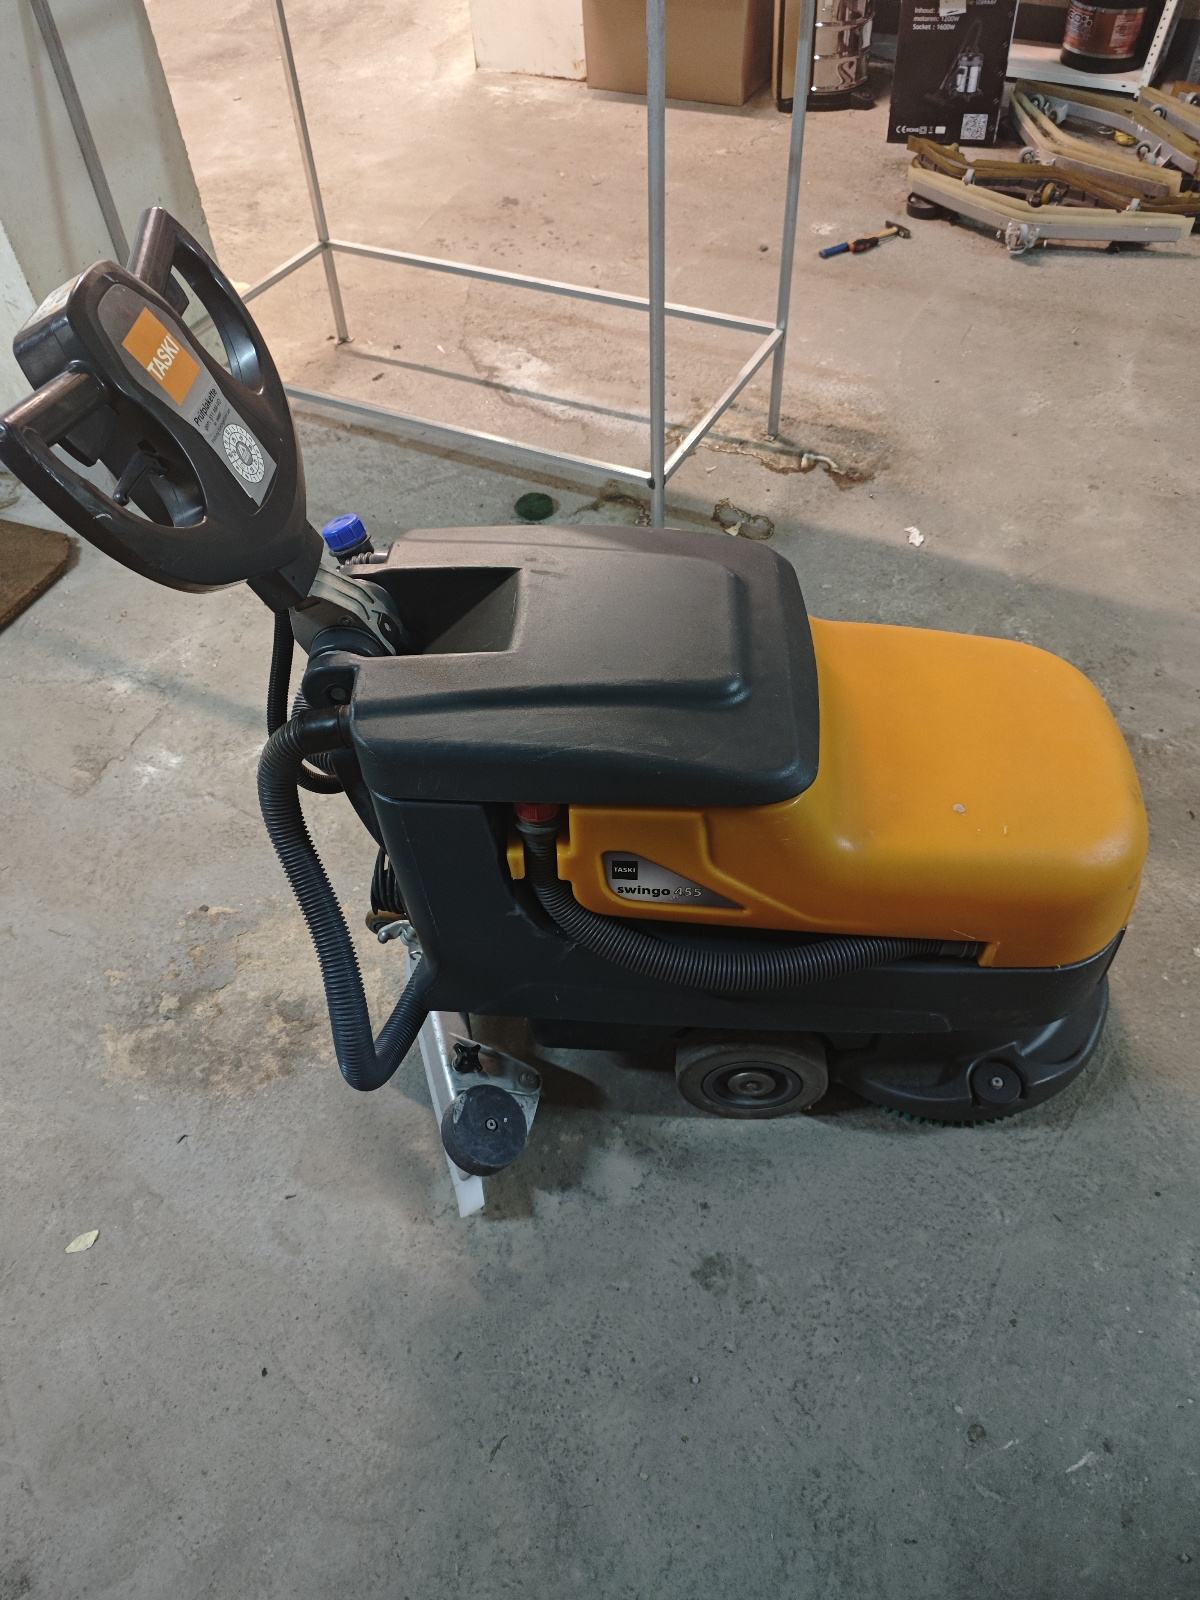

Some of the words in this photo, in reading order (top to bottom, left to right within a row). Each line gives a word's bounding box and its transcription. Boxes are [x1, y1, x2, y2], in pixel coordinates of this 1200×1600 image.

[146, 335, 180, 381] TASKI
[617, 885, 671, 897] swingo
[674, 887, 702, 897] 455
